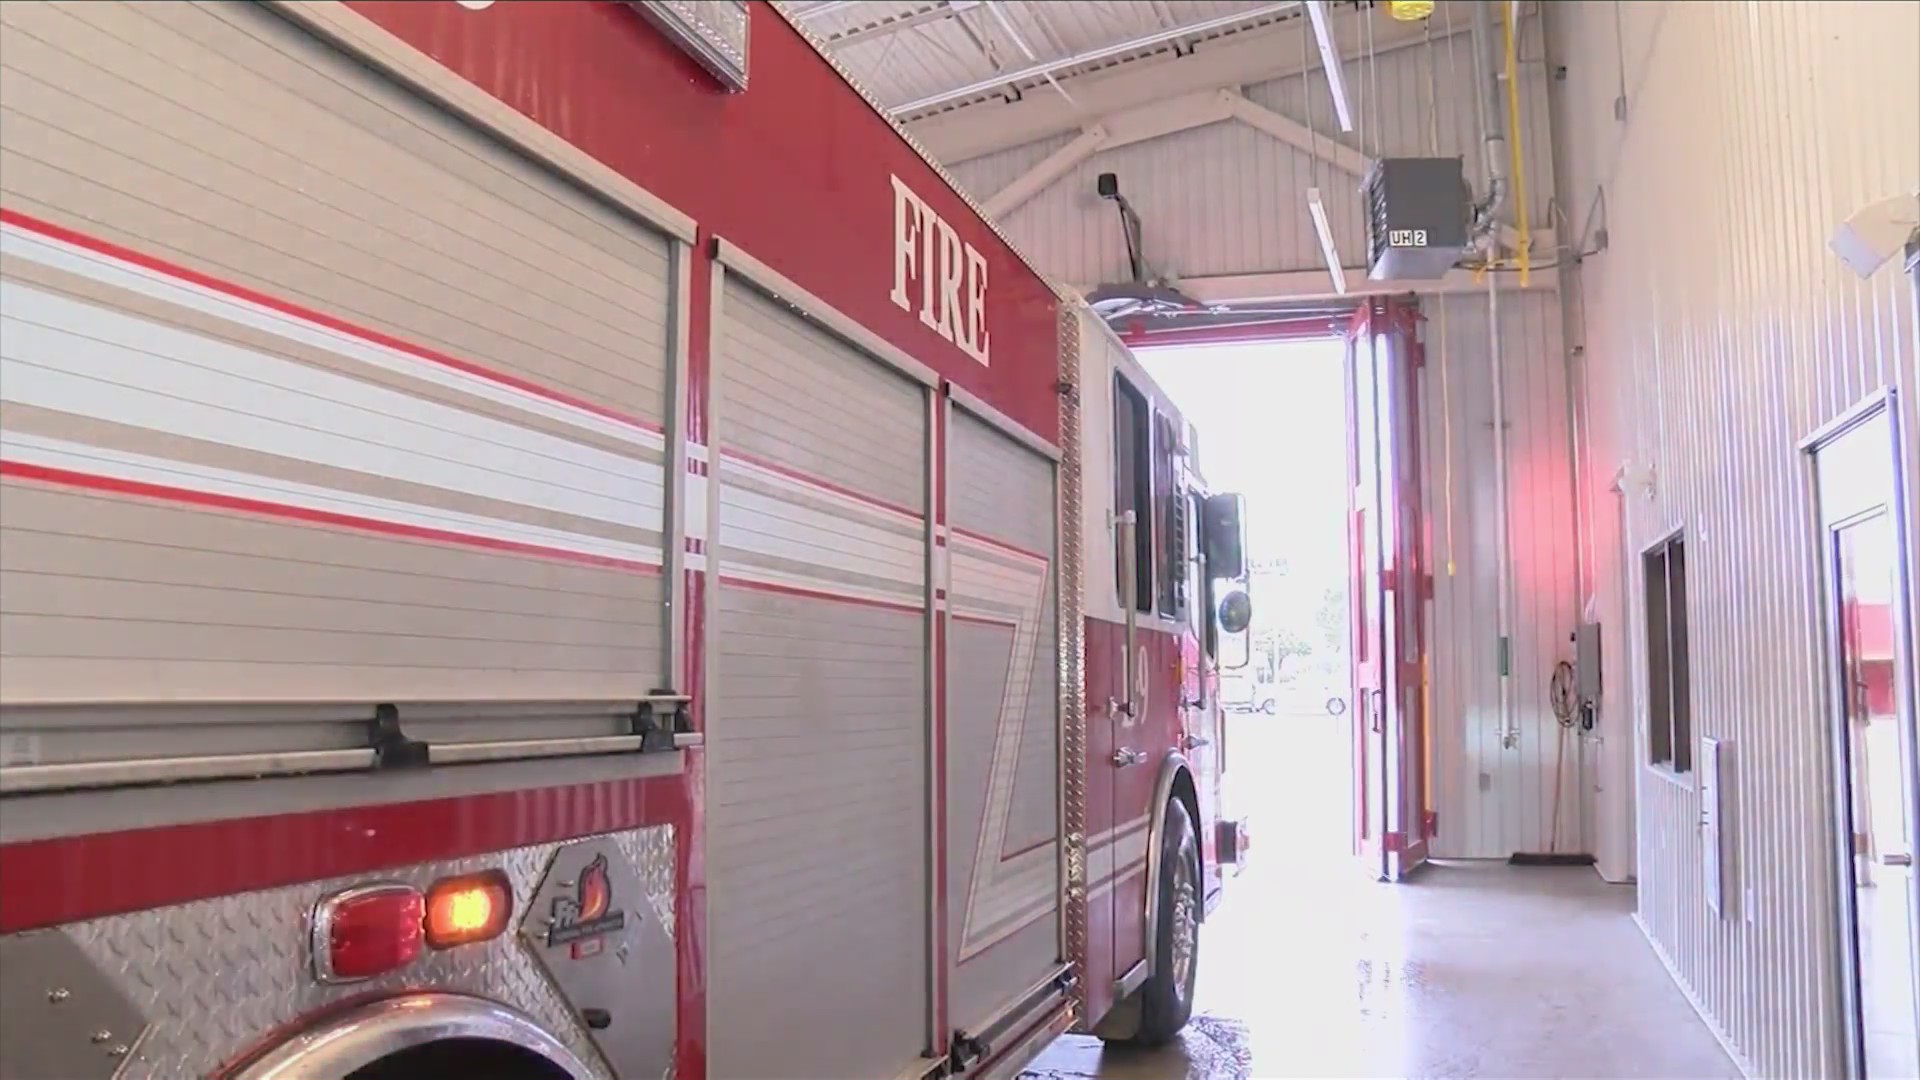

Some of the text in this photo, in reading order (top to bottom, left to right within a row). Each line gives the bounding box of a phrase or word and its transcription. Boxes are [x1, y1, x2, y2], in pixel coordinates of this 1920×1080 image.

[890, 173, 990, 368] FIRE
[1391, 231, 1425, 244] UH 2
